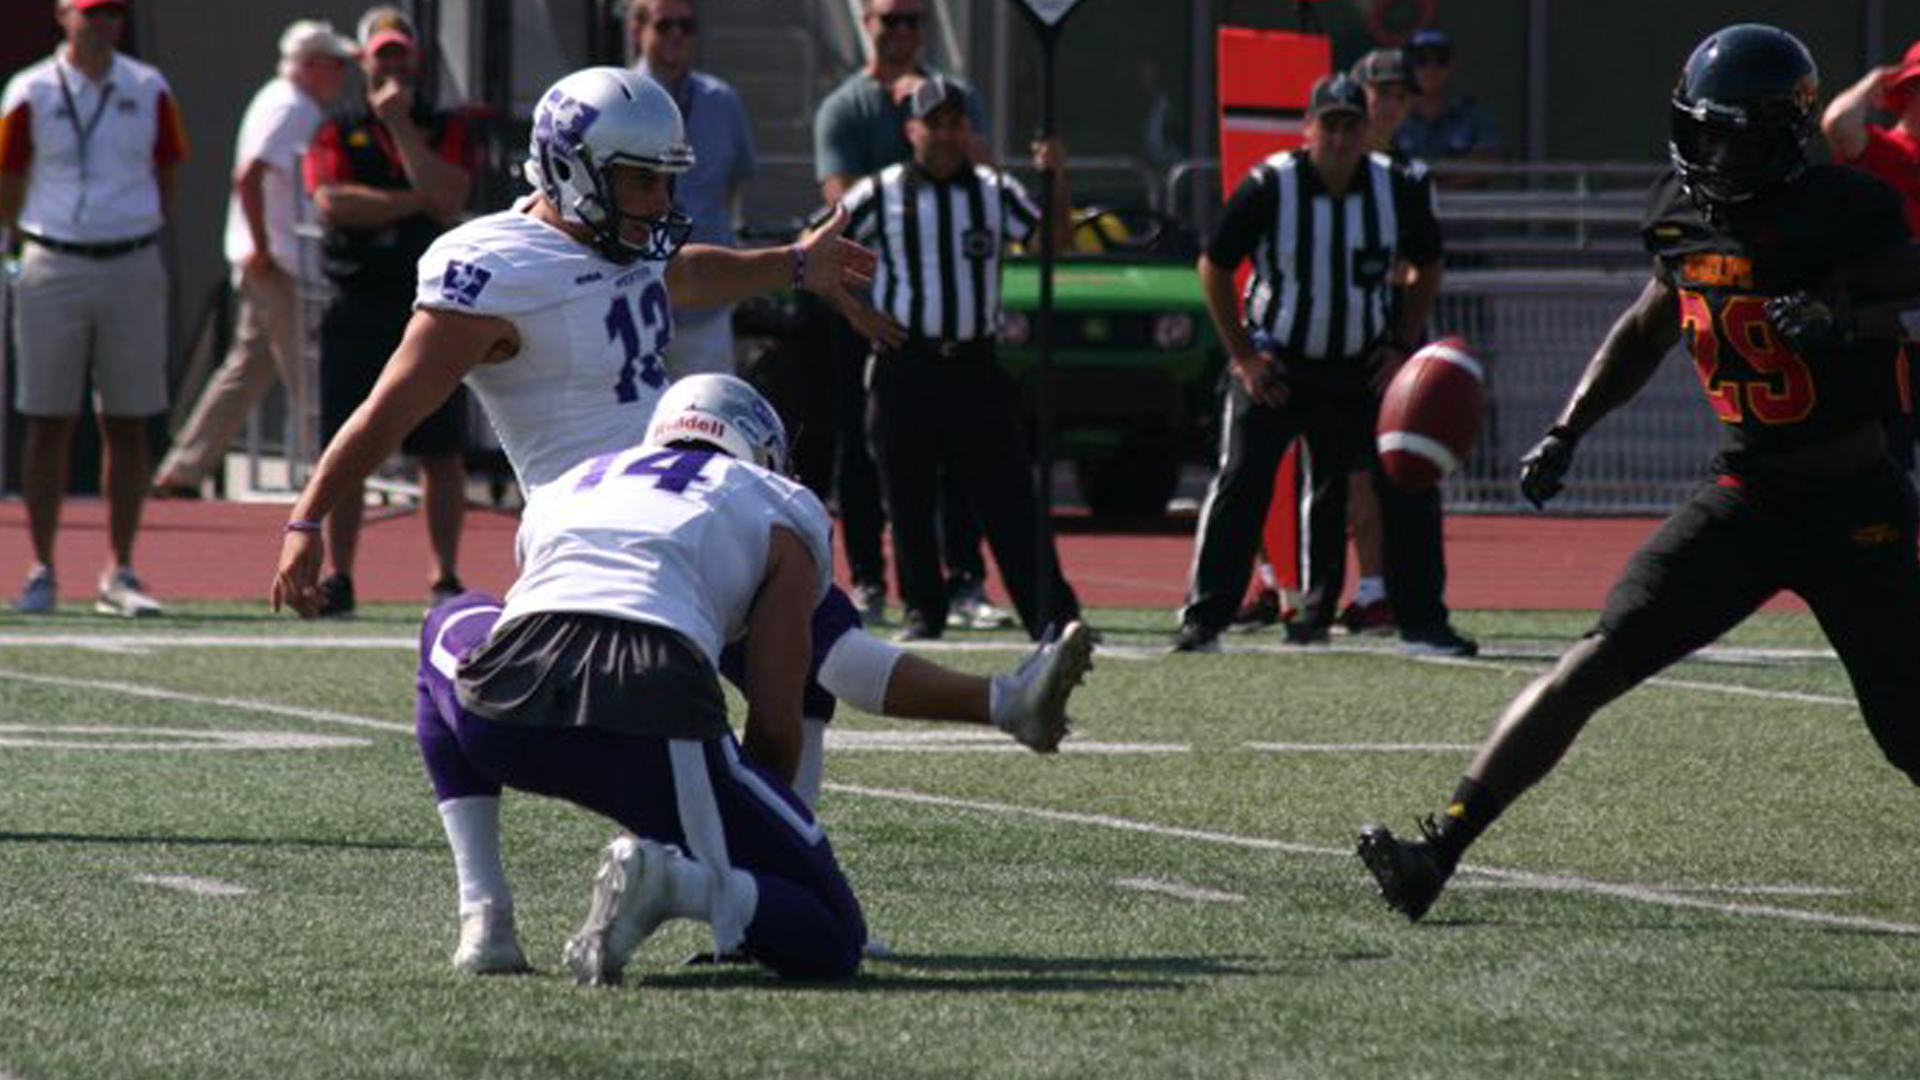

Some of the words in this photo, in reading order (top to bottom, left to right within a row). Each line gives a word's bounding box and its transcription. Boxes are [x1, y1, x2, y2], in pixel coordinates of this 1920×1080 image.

[604, 281, 671, 404] 13
[1678, 287, 1816, 425] 29
[655, 415, 726, 439] Riddell
[572, 448, 711, 494] 14
